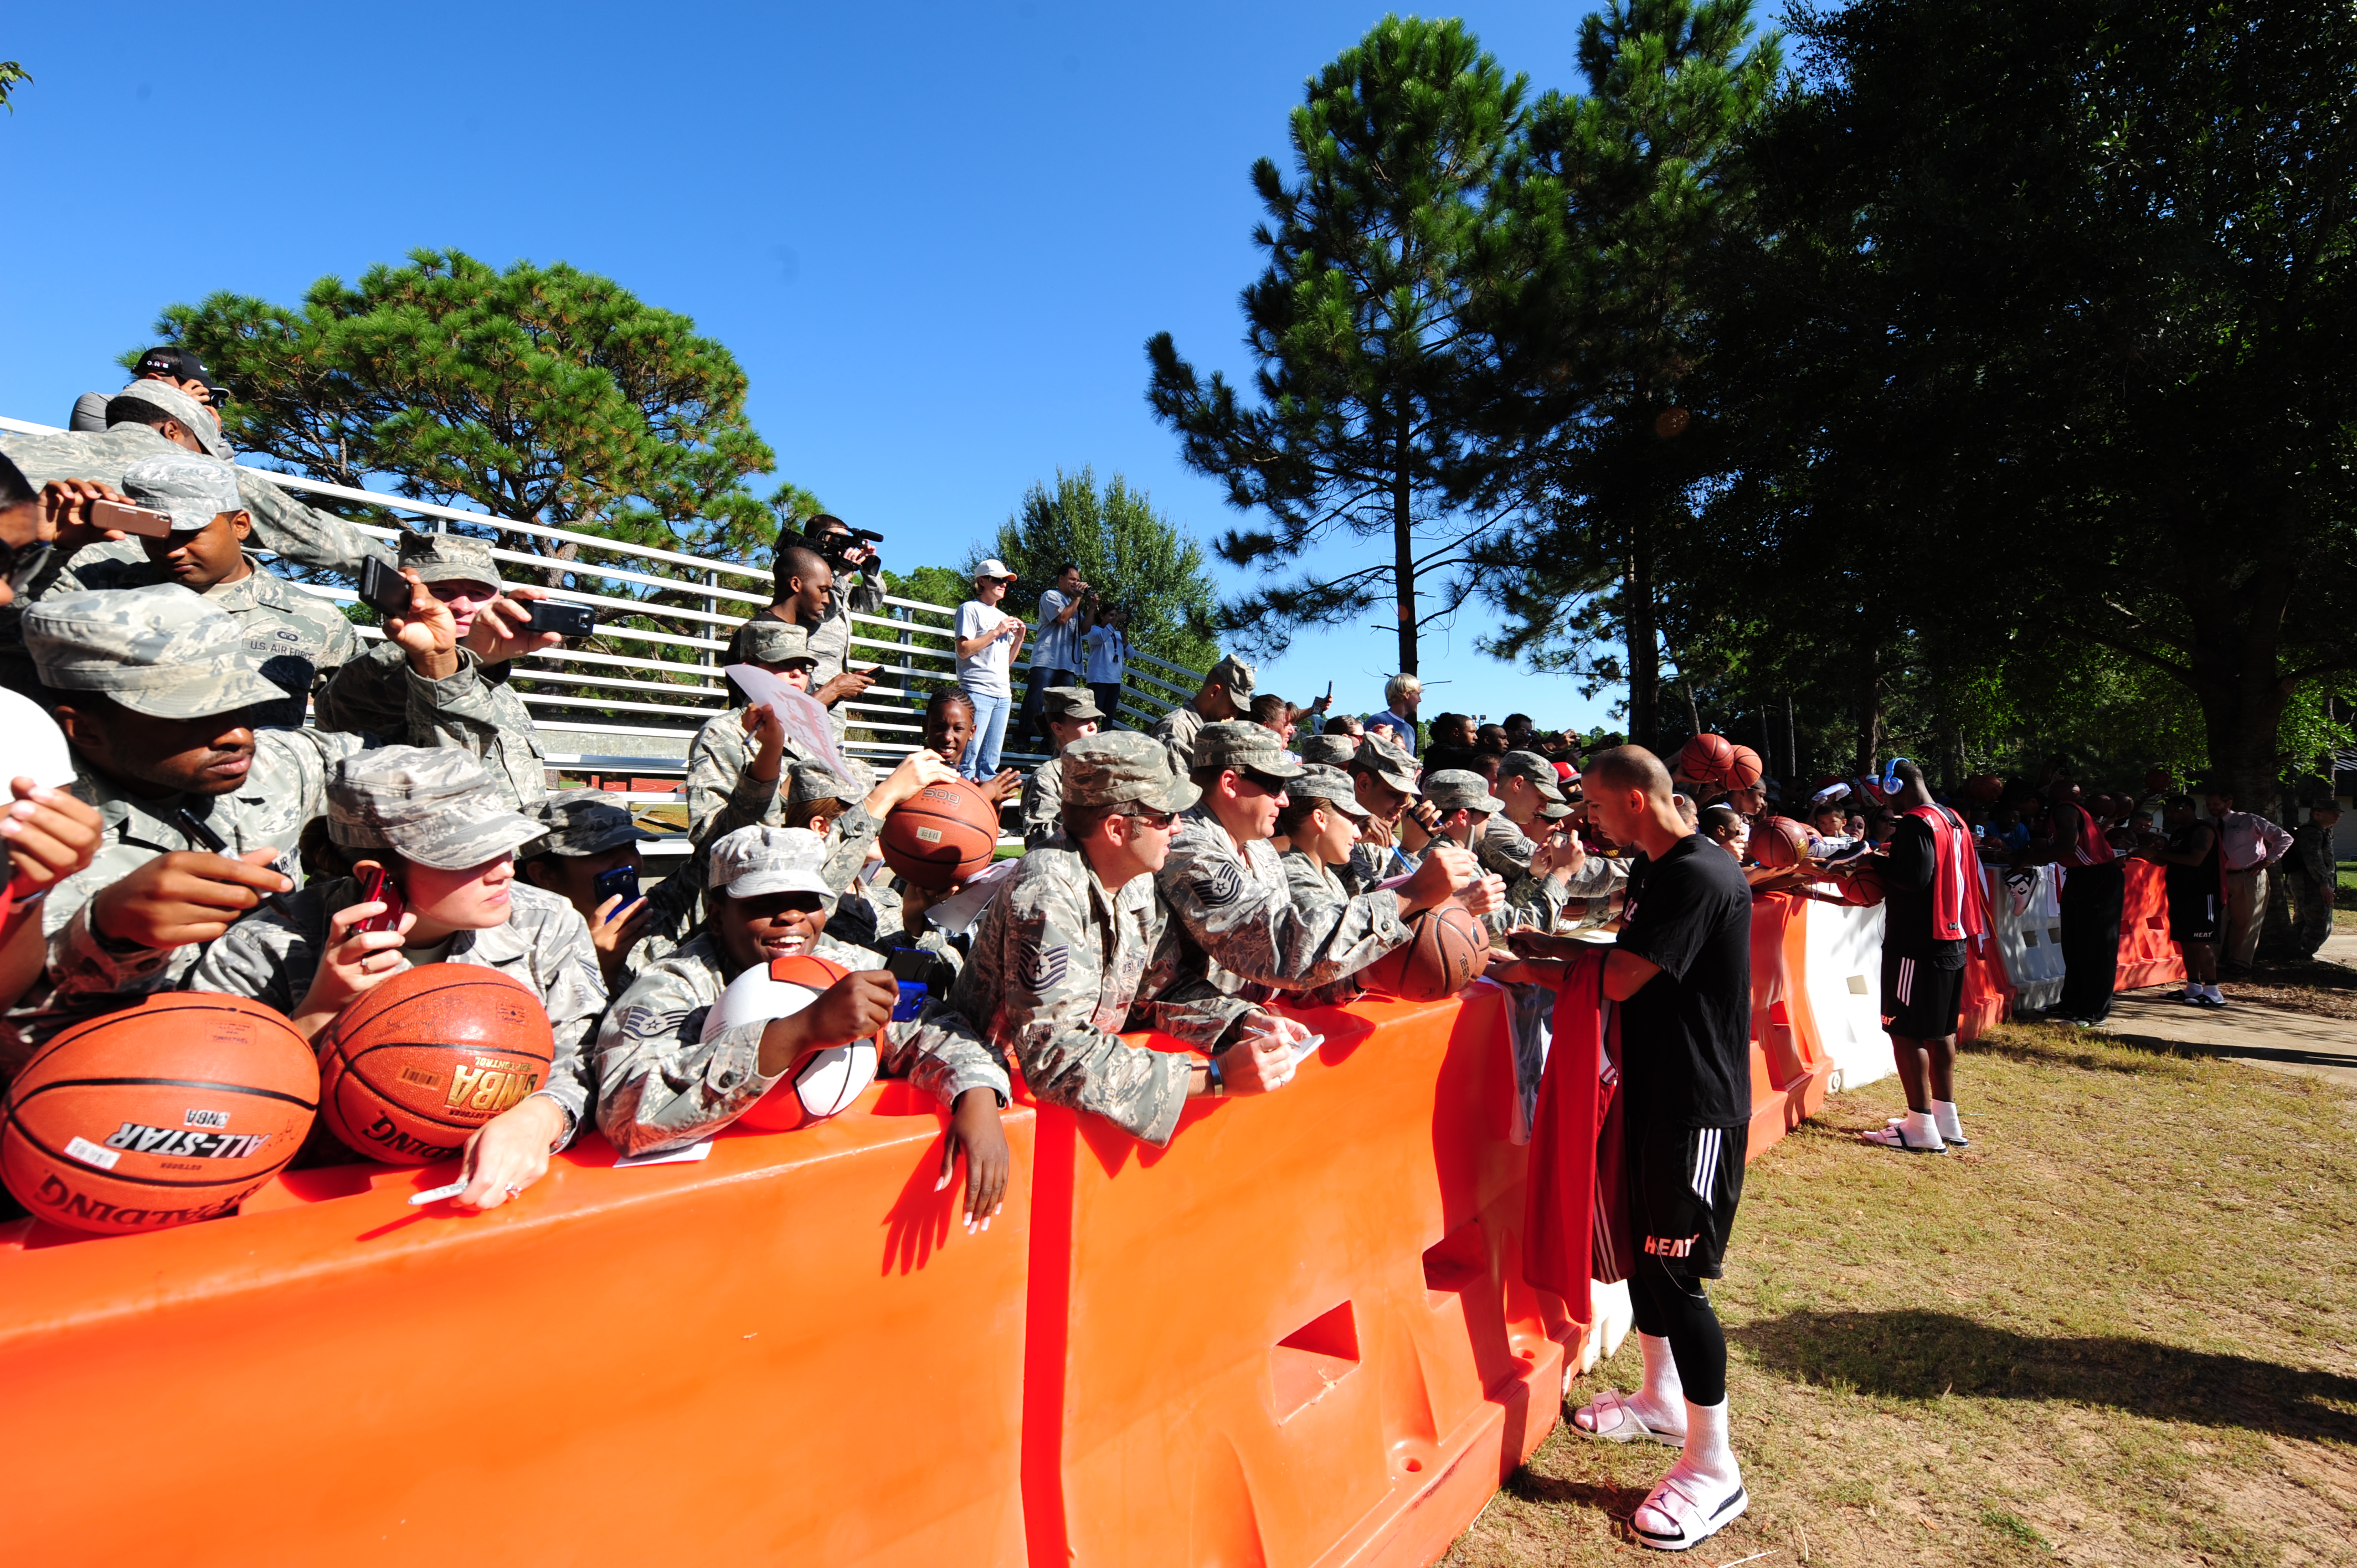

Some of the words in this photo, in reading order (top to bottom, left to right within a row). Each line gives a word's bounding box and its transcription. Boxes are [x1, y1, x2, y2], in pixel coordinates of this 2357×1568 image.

[250, 641, 267, 651] U.S.
[270, 643, 287, 655] AIR
[923, 787, 960, 804] 500
[1881, 1014, 1897, 1025] EAT
[475, 1056, 515, 1071] CONTROL
[444, 1064, 528, 1111] NBA
[184, 1108, 222, 1128] NBA
[104, 1122, 272, 1158] ALL-STAR
[1644, 1232, 1700, 1257] HEAT
